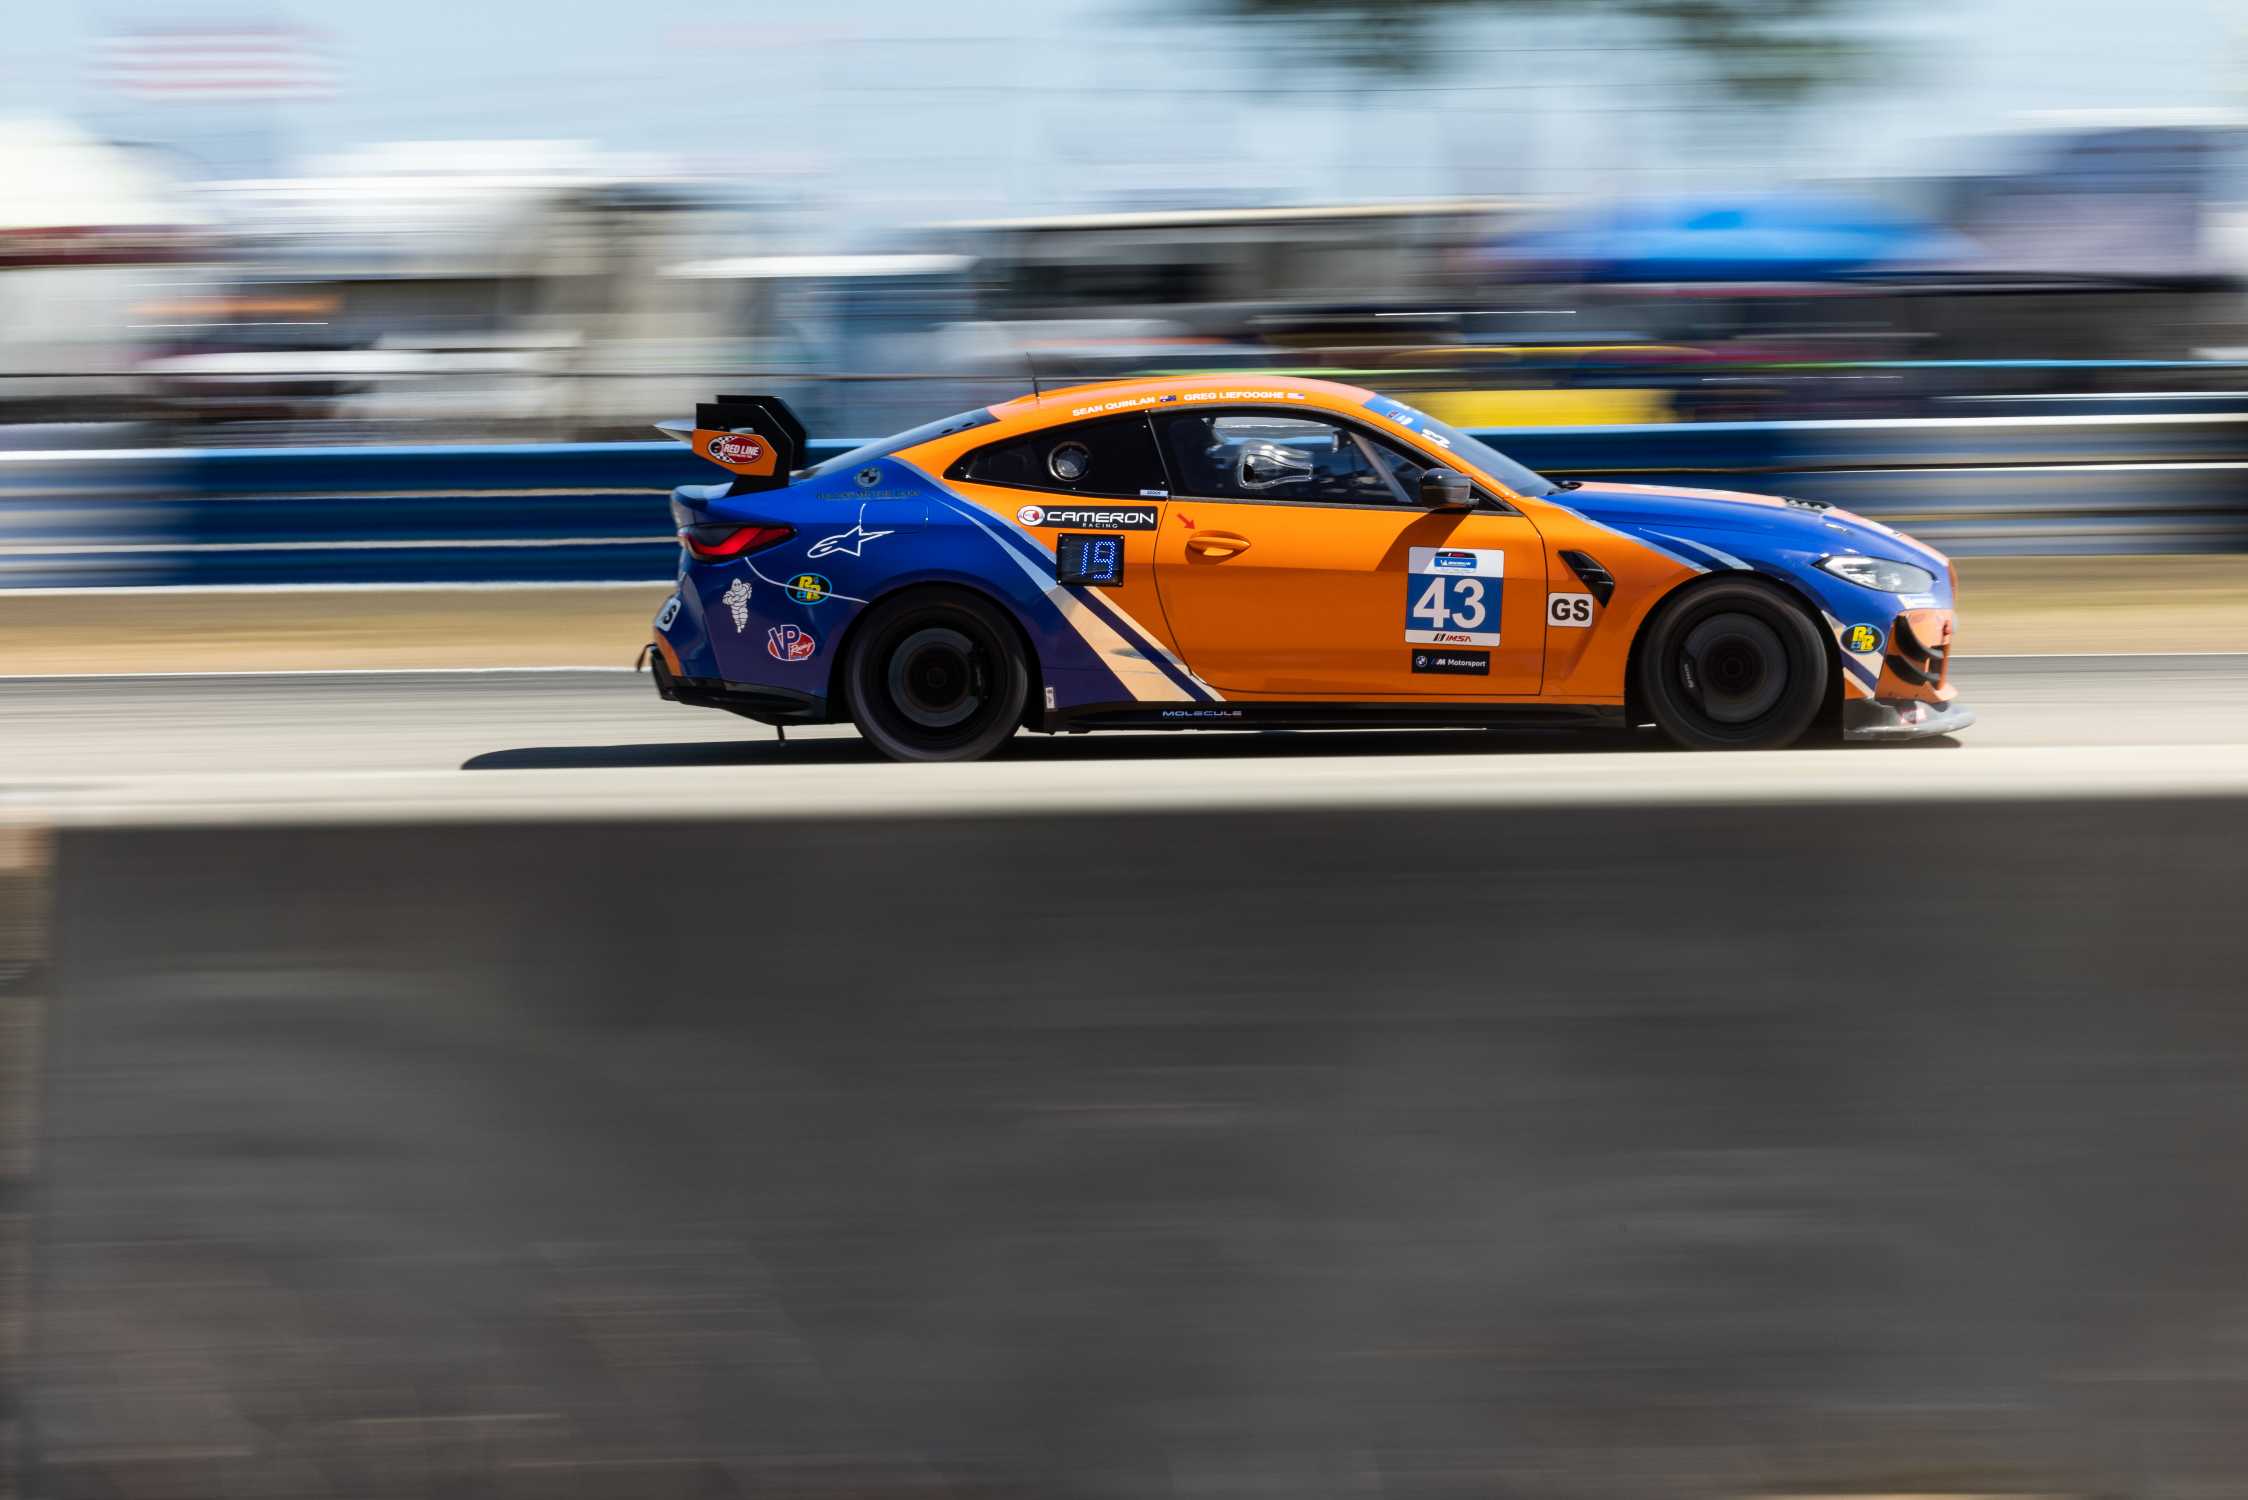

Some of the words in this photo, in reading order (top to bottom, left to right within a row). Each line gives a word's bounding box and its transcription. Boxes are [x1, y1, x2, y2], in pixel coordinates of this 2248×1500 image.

[1183, 391, 1217, 401] GREG
[1218, 391, 1285, 400] LIEFOOGHE
[1072, 404, 1104, 416] SEAN
[1105, 397, 1155, 410] QUINLAN
[724, 443, 741, 455] RED
[741, 444, 760, 456] LINE
[1047, 511, 1154, 524] CAMERON
[1081, 540, 1116, 580] 19
[1413, 577, 1486, 629] 43
[1551, 598, 1590, 622] GS
[768, 624, 801, 661] VP
[1447, 658, 1486, 668] Motorsport
